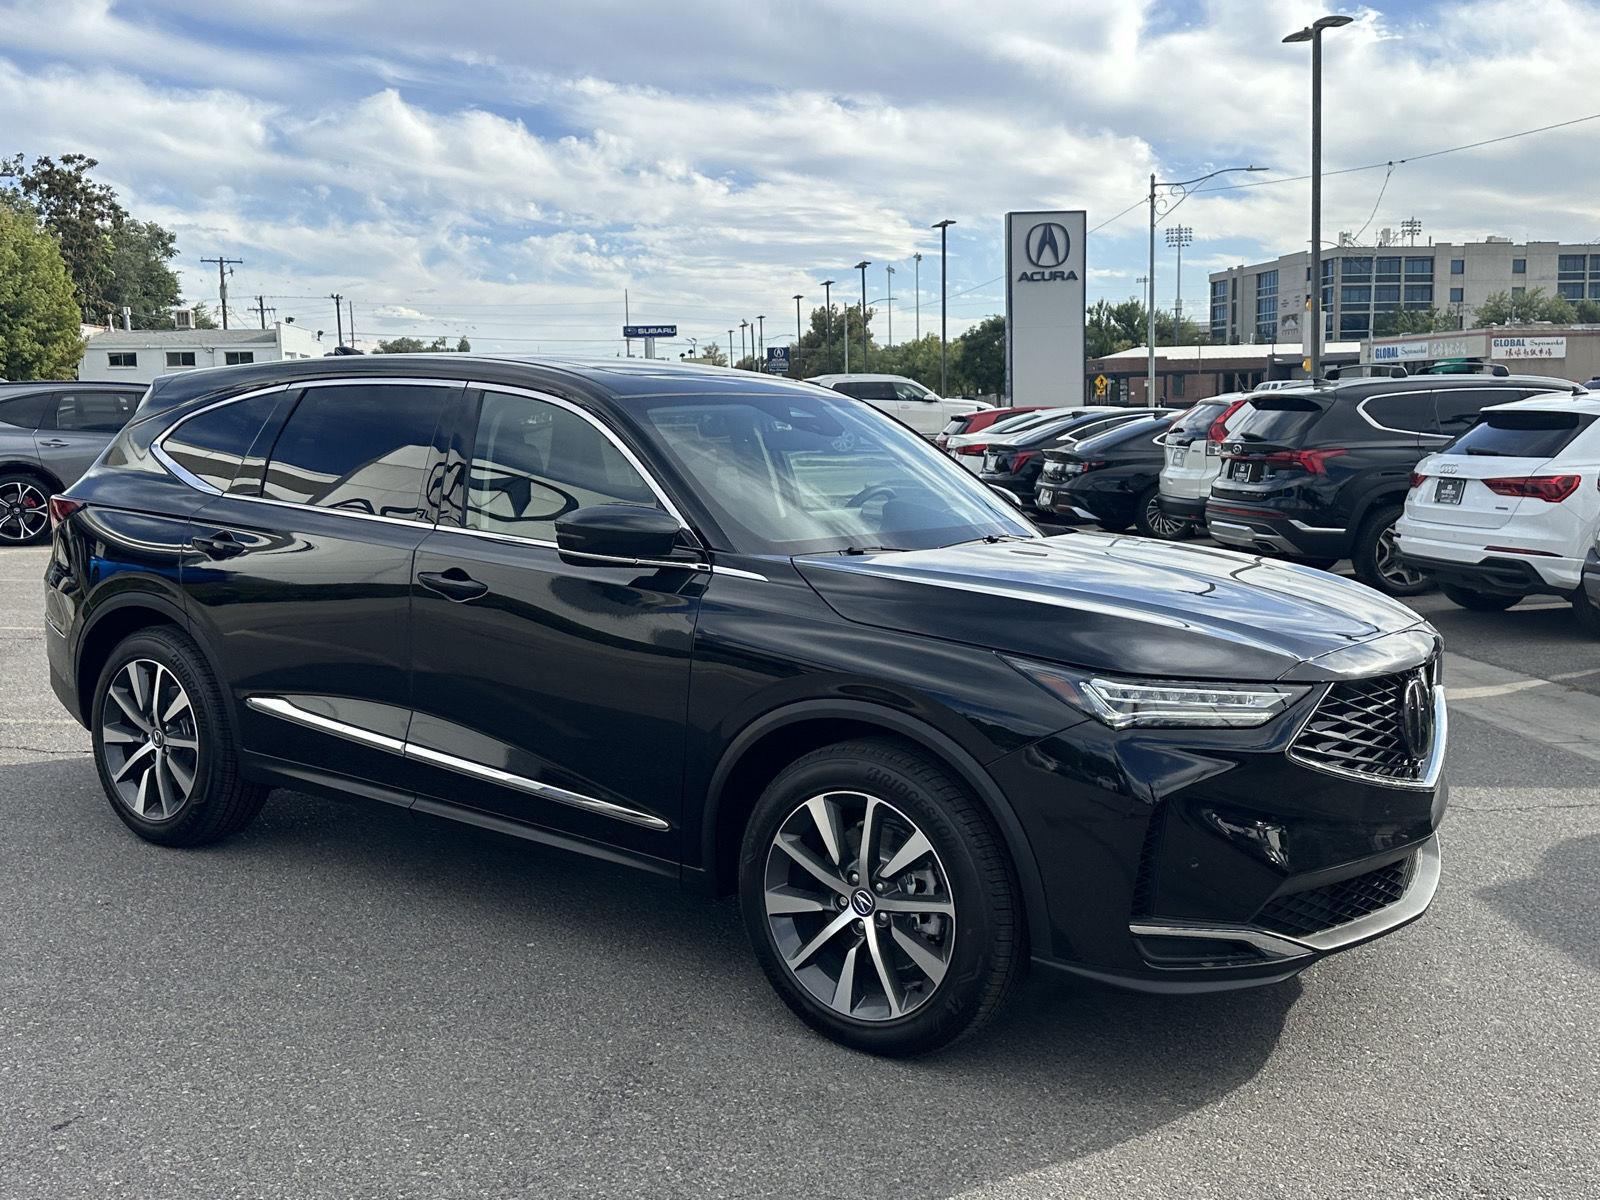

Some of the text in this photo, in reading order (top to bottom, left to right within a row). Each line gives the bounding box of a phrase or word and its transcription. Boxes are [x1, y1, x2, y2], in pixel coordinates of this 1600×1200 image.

[1018, 271, 1078, 282] ACURA
[1493, 339, 1526, 347] GLOBAL
[1375, 346, 1399, 359] GLOBAL
[864, 766, 959, 857] BRIDGESTON
